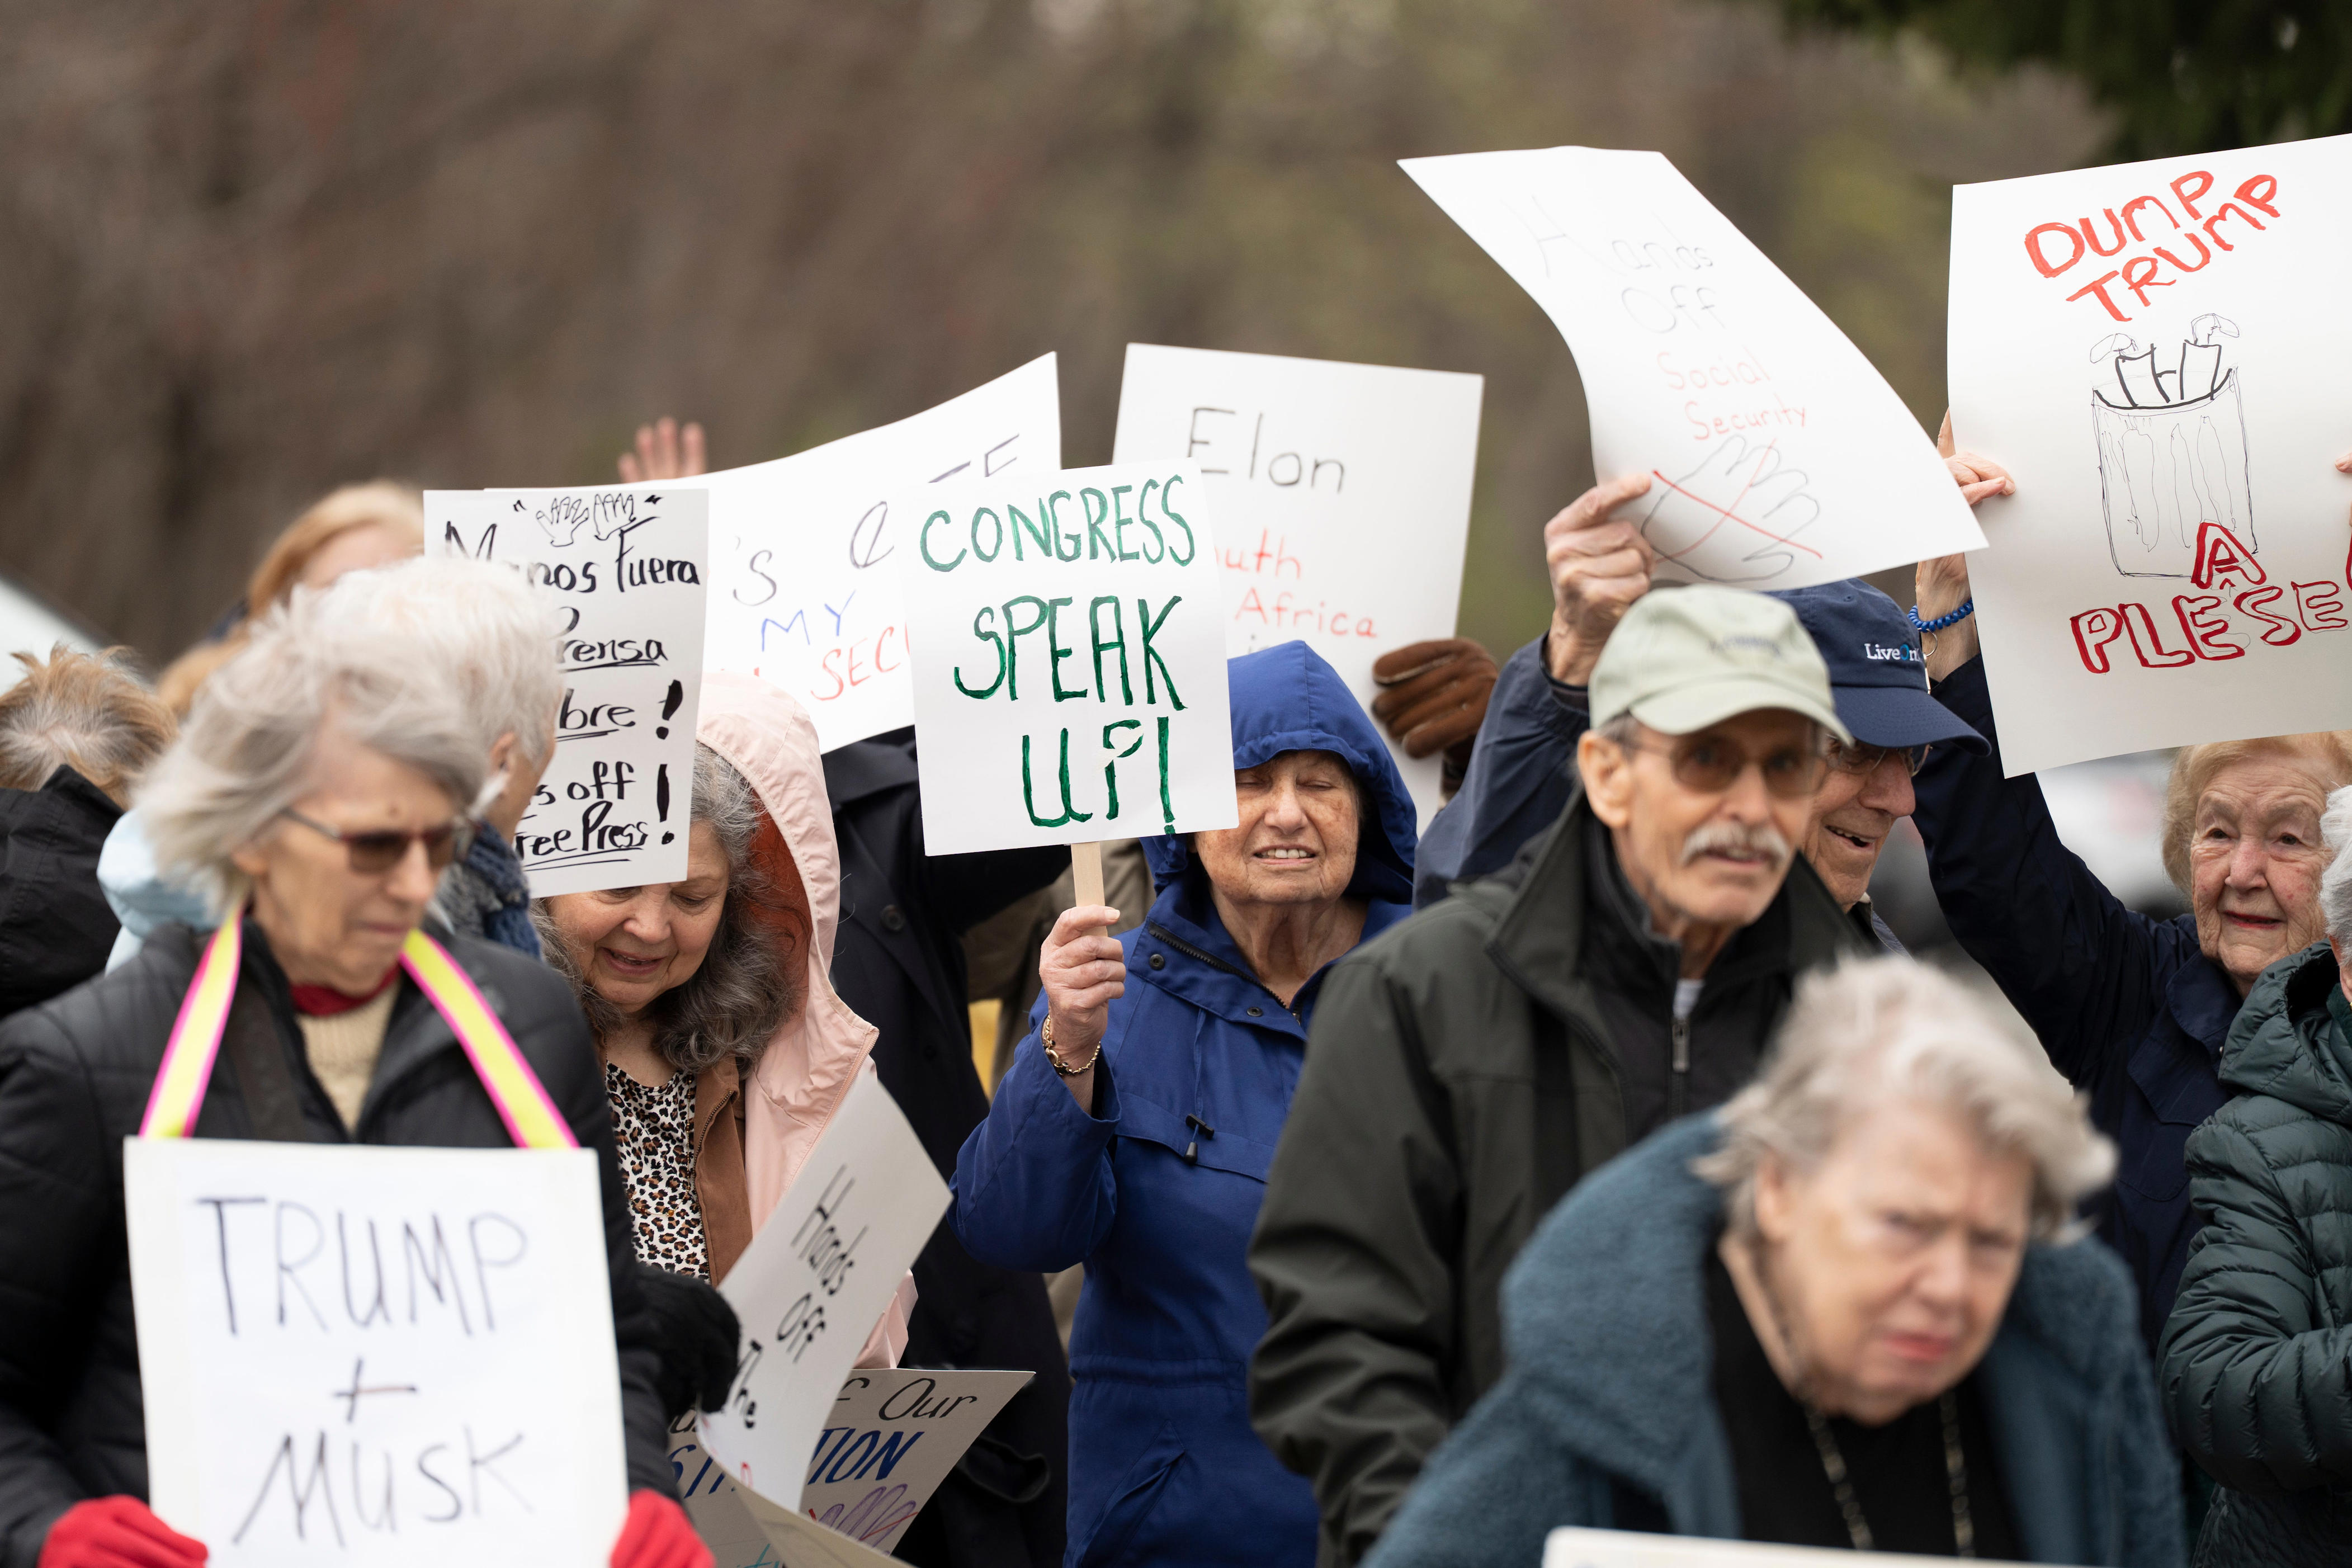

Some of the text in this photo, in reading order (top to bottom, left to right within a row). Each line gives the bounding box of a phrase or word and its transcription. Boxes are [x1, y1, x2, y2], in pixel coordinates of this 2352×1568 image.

[2024, 170, 2214, 278] DUMP
[2066, 174, 2281, 322] TRUMP
[1621, 284, 1726, 334] Off
[1656, 344, 1772, 391] Social
[1187, 407, 1344, 494] Elon
[1683, 392, 1807, 441] Security
[445, 516, 701, 593] Mnos Fuera
[920, 474, 1196, 573] CONGRESS
[1214, 528, 1302, 580] uth
[761, 589, 856, 653] MY
[1234, 587, 1378, 638] Africa
[555, 639, 668, 663] rensa
[953, 595, 1188, 711] SPEAK
[566, 761, 636, 800] off
[1021, 716, 1177, 834] UP!
[516, 829, 578, 860] ree
[791, 1163, 868, 1297] Hands
[195, 1197, 528, 1336] TRUMP
[777, 1292, 826, 1363] Off
[878, 1377, 977, 1421] Our
[231, 1424, 536, 1549] MUSK
